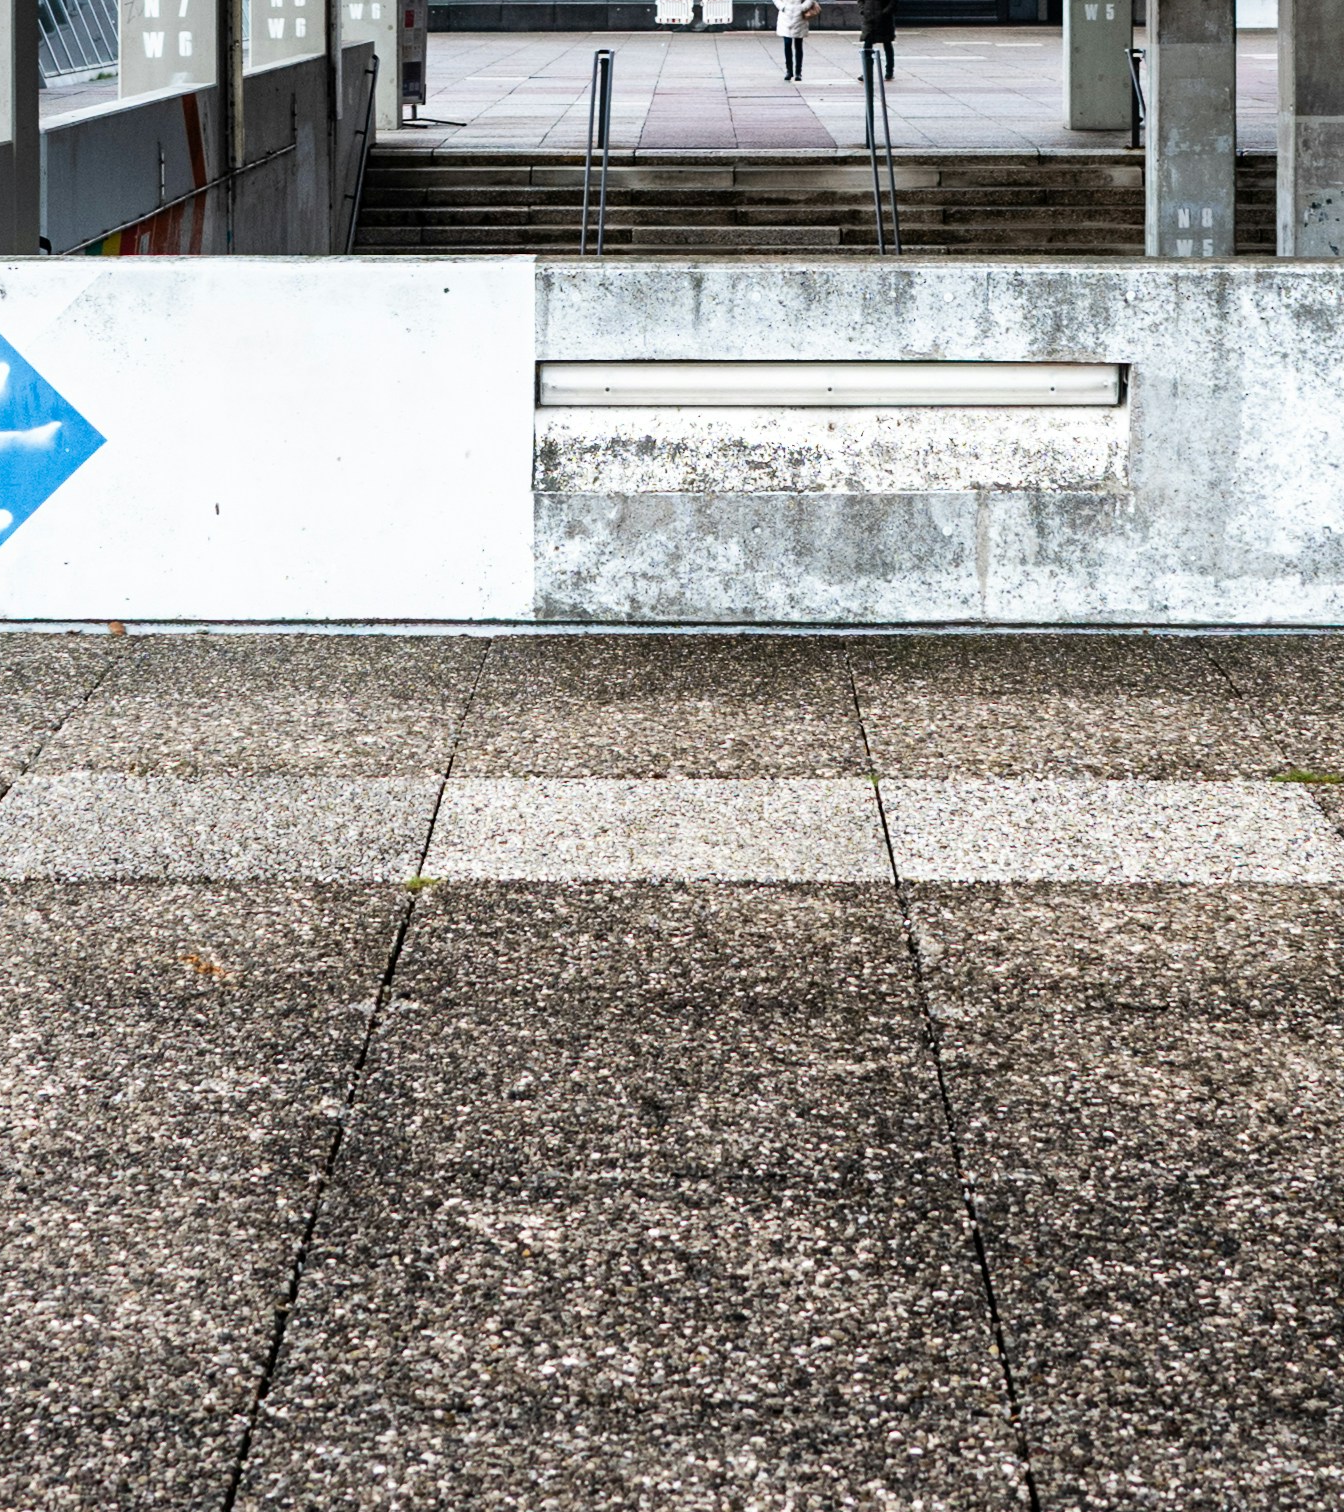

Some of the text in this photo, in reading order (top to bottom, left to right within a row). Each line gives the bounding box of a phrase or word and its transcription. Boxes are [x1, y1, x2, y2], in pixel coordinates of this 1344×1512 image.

[267, 17, 306, 39] W 6
[142, 30, 193, 58] W 6
[1177, 207, 1213, 228] N 8
[1176, 239, 1213, 256] W 5
